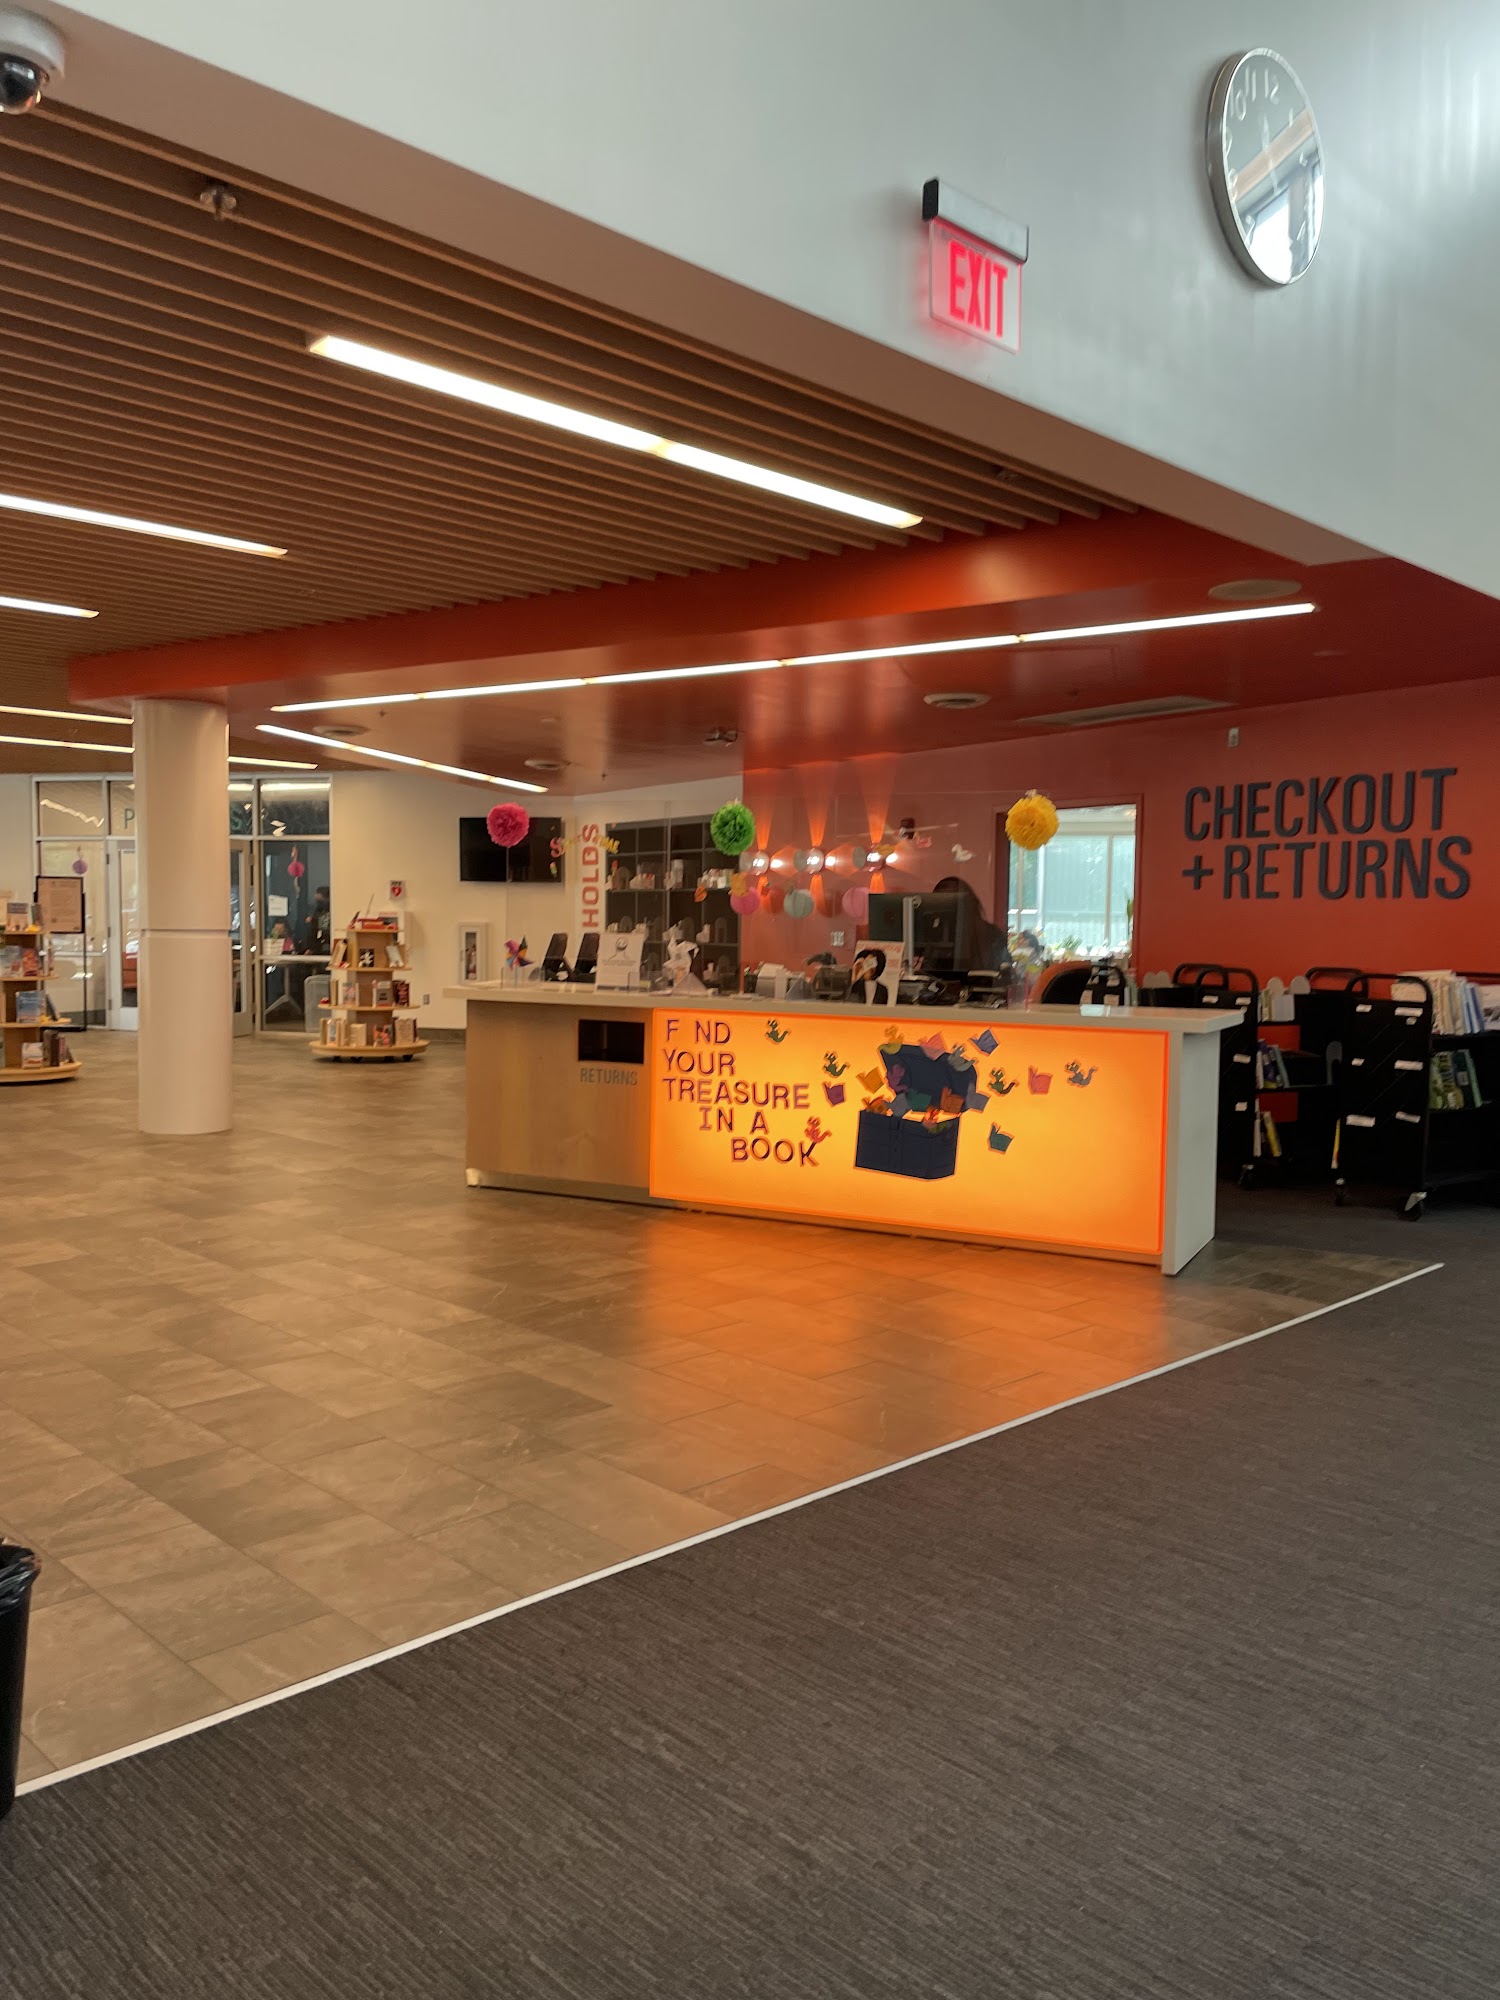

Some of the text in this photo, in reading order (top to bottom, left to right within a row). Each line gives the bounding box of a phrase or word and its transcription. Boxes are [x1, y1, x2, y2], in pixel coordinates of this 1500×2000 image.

[948, 238, 1008, 338] EXIT
[1183, 767, 1457, 842] CHECKOUT
[582, 823, 599, 928] HOLDS
[580, 1067, 639, 1086] RETURNS
[662, 1048, 736, 1076] YOUR
[662, 1078, 810, 1109] TREASURE
[700, 1107, 769, 1135] IN A
[731, 1137, 819, 1168] BOOK
